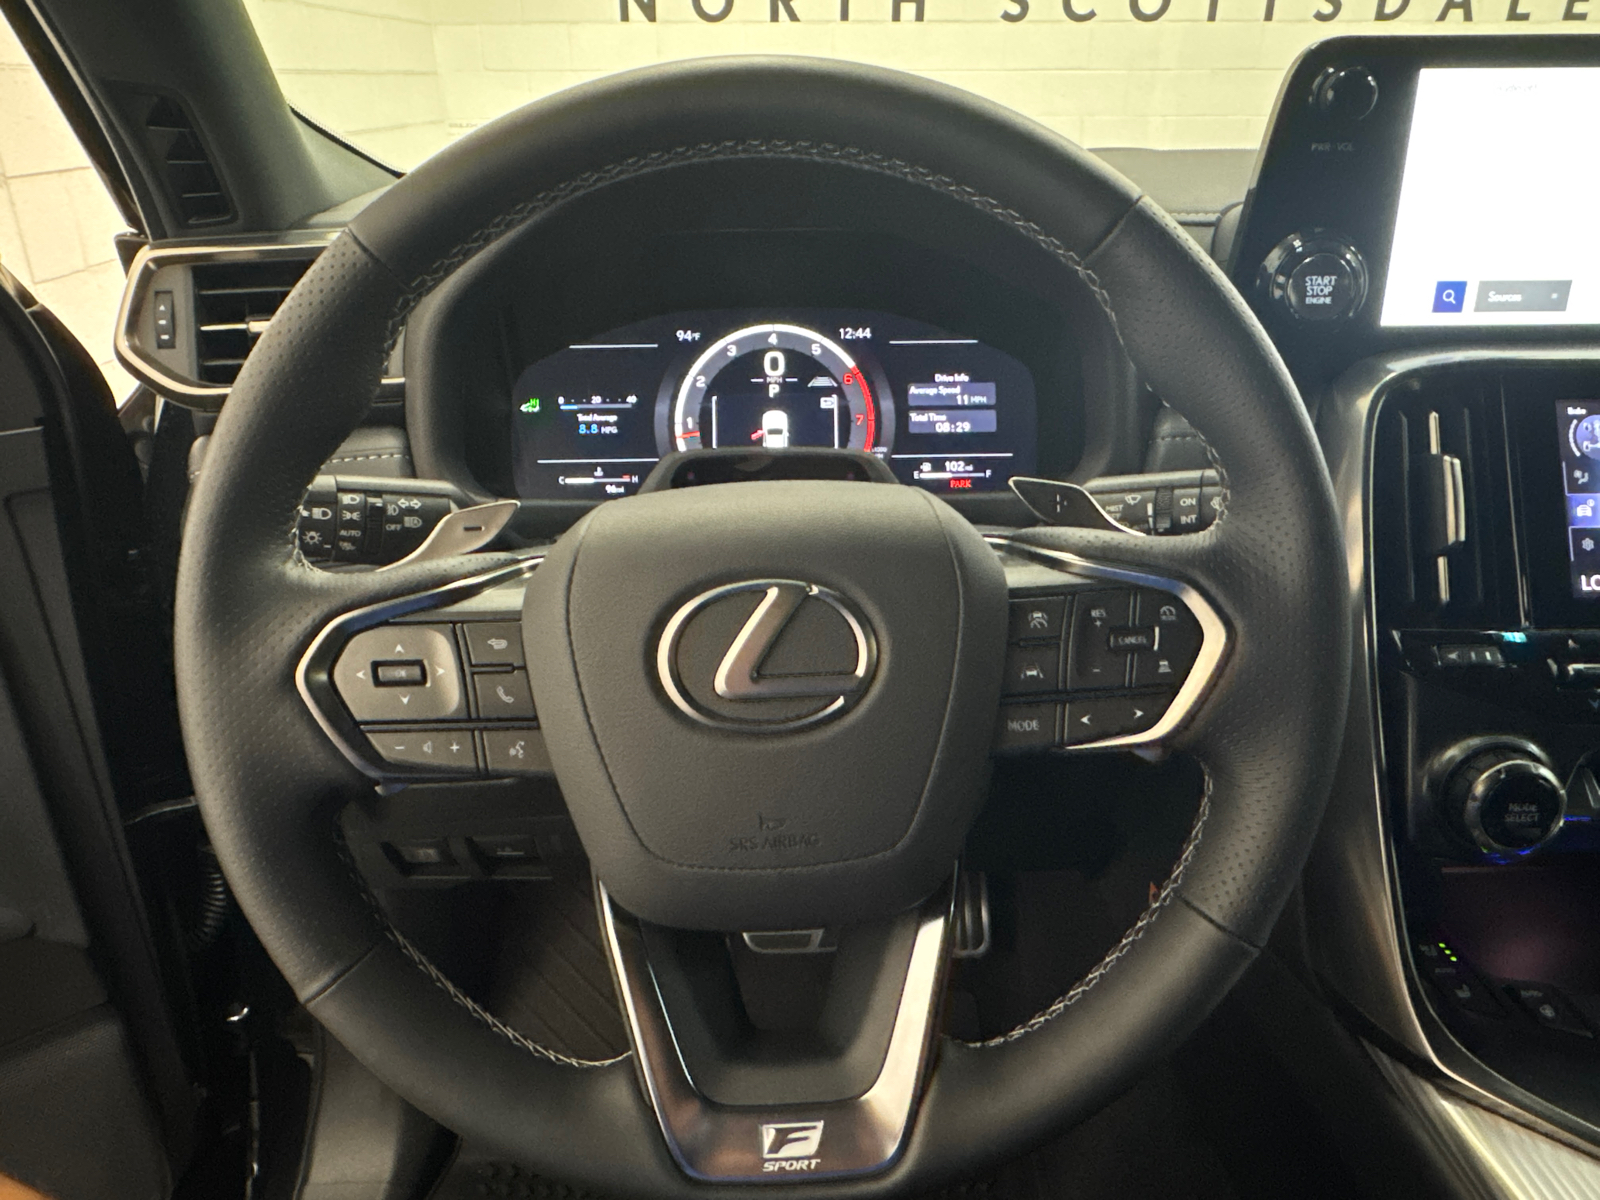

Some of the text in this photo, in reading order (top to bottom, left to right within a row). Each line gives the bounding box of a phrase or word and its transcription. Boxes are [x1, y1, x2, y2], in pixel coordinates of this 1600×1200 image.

[1305, 275, 1337, 286] START
[1306, 286, 1333, 296] STOP
[1305, 297, 1332, 305] ENGINE
[768, 333, 778, 346] 4
[839, 328, 872, 342] 12:44
[727, 344, 737, 357] 3
[812, 343, 822, 355] 5
[696, 375, 707, 388] 2
[843, 374, 854, 385] 6
[769, 384, 780, 398] P
[909, 385, 961, 396] Average Speed
[956, 394, 987, 405] 11 MPH
[686, 416, 693, 430] 1
[856, 414, 865, 426] 7
[910, 413, 947, 422] Total Time
[935, 422, 971, 433] 08:29
[632, 475, 639, 483] H
[914, 471, 920, 480] E
[986, 470, 992, 478] F
[949, 480, 972, 488] PARK
[1181, 497, 1197, 507] ON
[1181, 515, 1197, 525] INT
[386, 523, 403, 532] OFF
[340, 529, 361, 538] AUTO
[1008, 719, 1039, 732] MODE
[1504, 812, 1539, 822] SELECT
[762, 1159, 821, 1171] SPORT
